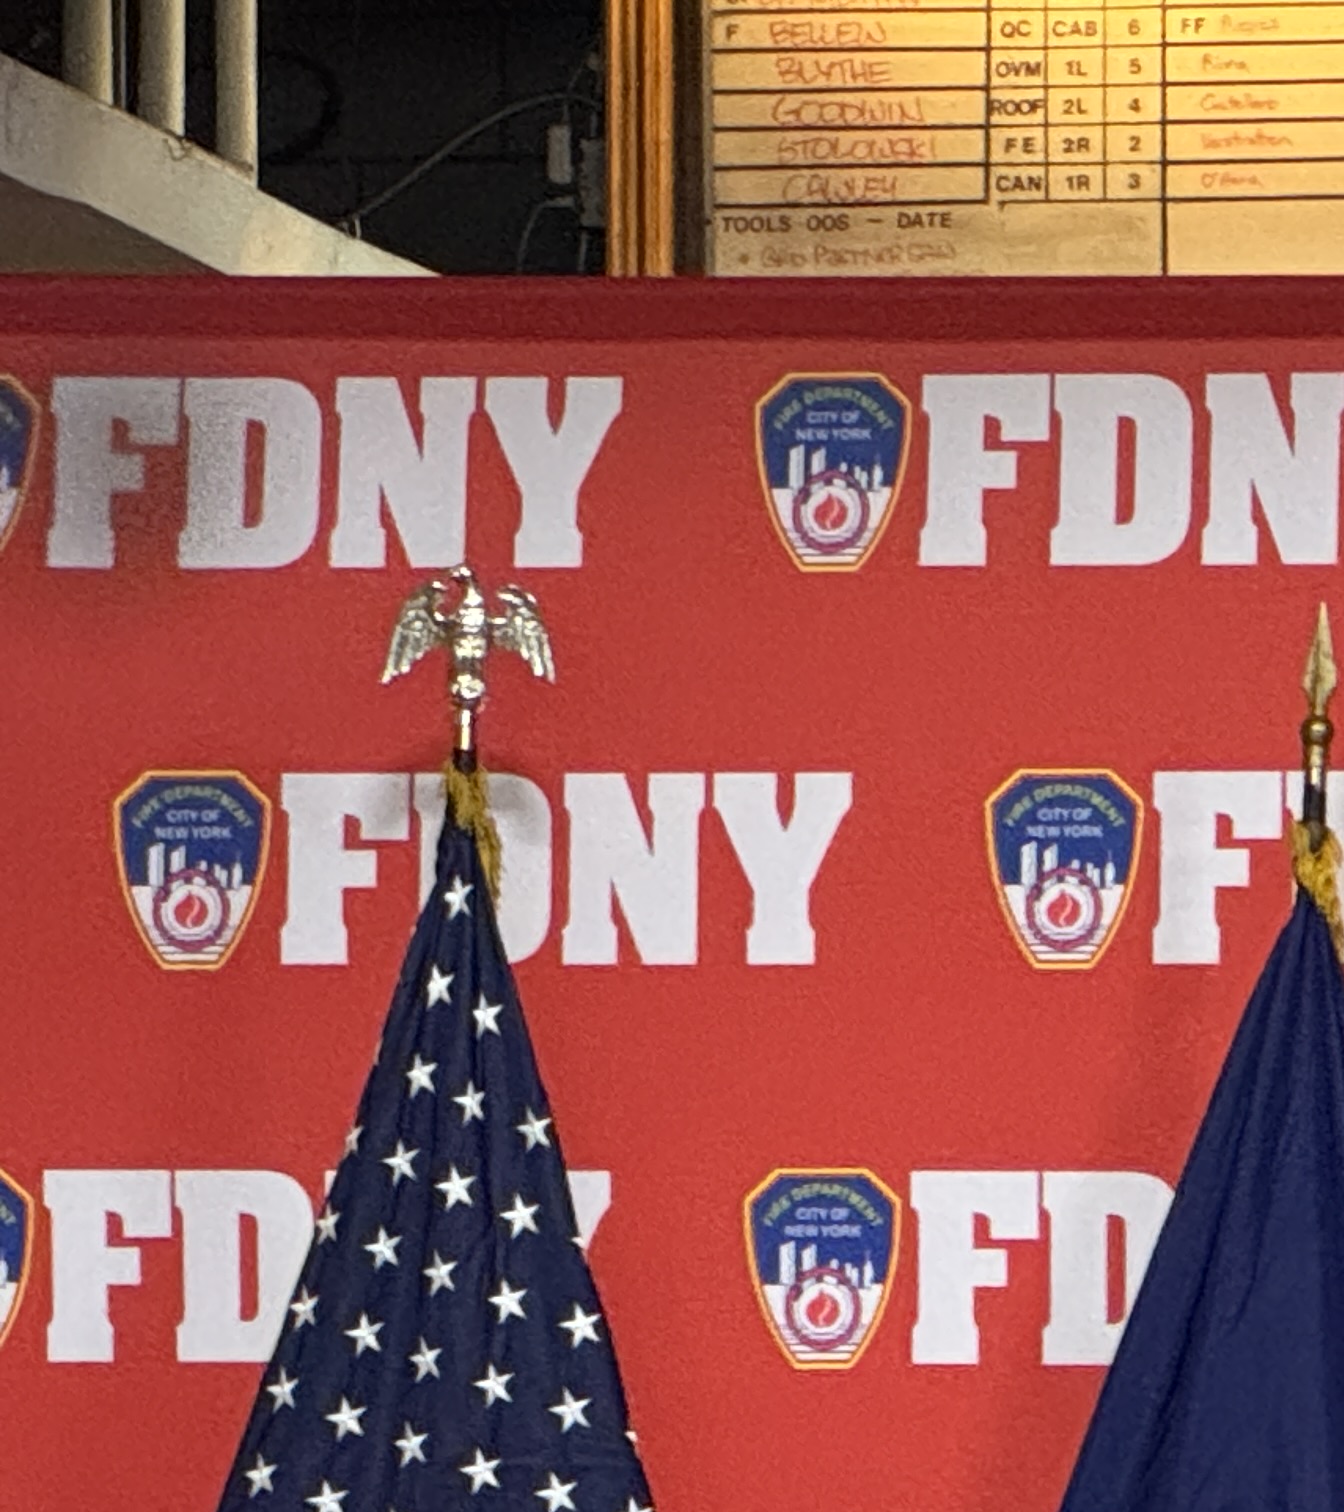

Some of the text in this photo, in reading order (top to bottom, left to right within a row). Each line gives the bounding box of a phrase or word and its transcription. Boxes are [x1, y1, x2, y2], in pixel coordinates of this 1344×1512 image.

[1052, 20, 1098, 37] CAB
[1127, 18, 1141, 36] 6
[1181, 17, 1206, 35] FF
[995, 57, 1142, 78] OVM 1L 5
[989, 97, 1142, 116] ROOF 2L 4
[1062, 137, 1091, 153] 2R
[1127, 135, 1142, 153] 2
[995, 173, 1142, 193] CAN 1R 3
[722, 215, 792, 233] TOOLS
[806, 213, 850, 232] OOS
[896, 211, 953, 229] DATE
[806, 410, 861, 424] CITY OF
[795, 428, 872, 441] NEW YORK
[47, 377, 622, 568] FDNY
[165, 809, 221, 823] CITY OF
[1036, 807, 1092, 821] CITY OF
[154, 827, 232, 840] NEW YORK
[1026, 825, 1103, 838] NEW YORK
[795, 1207, 850, 1221] CITY OF
[784, 1225, 862, 1238] NEW YORK
